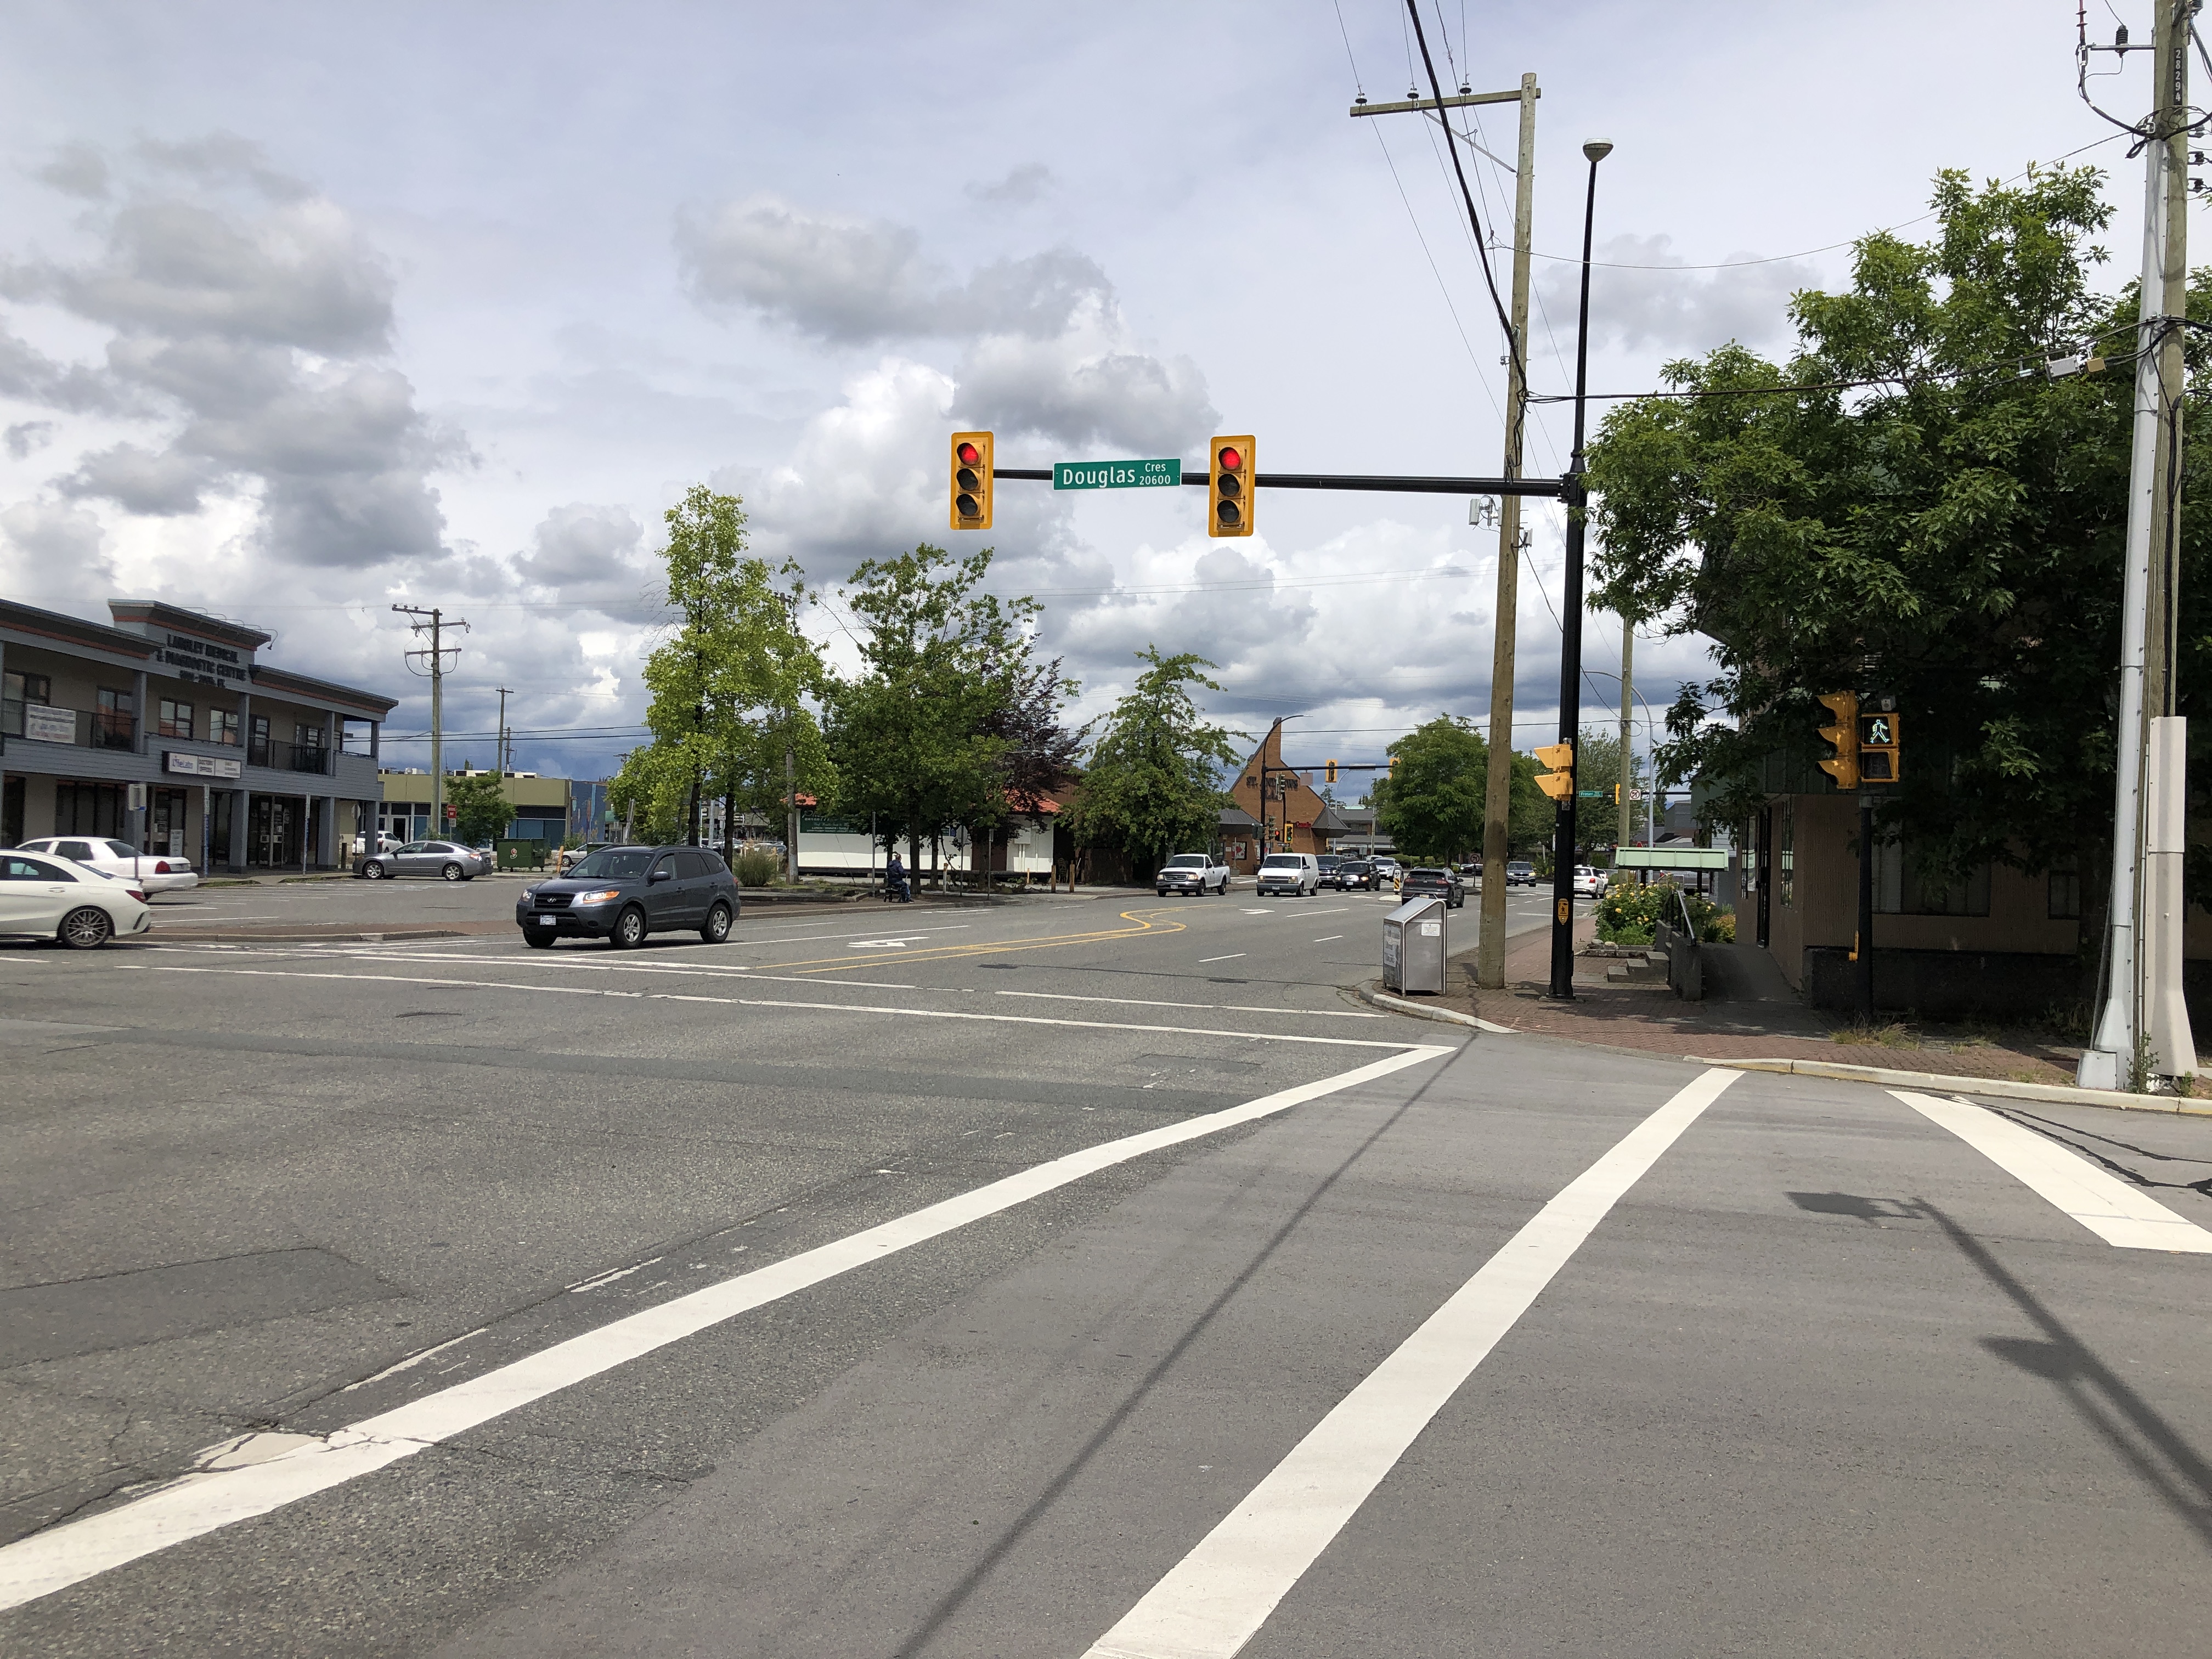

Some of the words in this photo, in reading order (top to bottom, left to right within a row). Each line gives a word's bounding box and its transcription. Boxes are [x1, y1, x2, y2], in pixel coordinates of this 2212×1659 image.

[1145, 463, 1166, 472] Cres
[1063, 466, 1136, 488] Douglas
[1139, 475, 1171, 486] 20600
